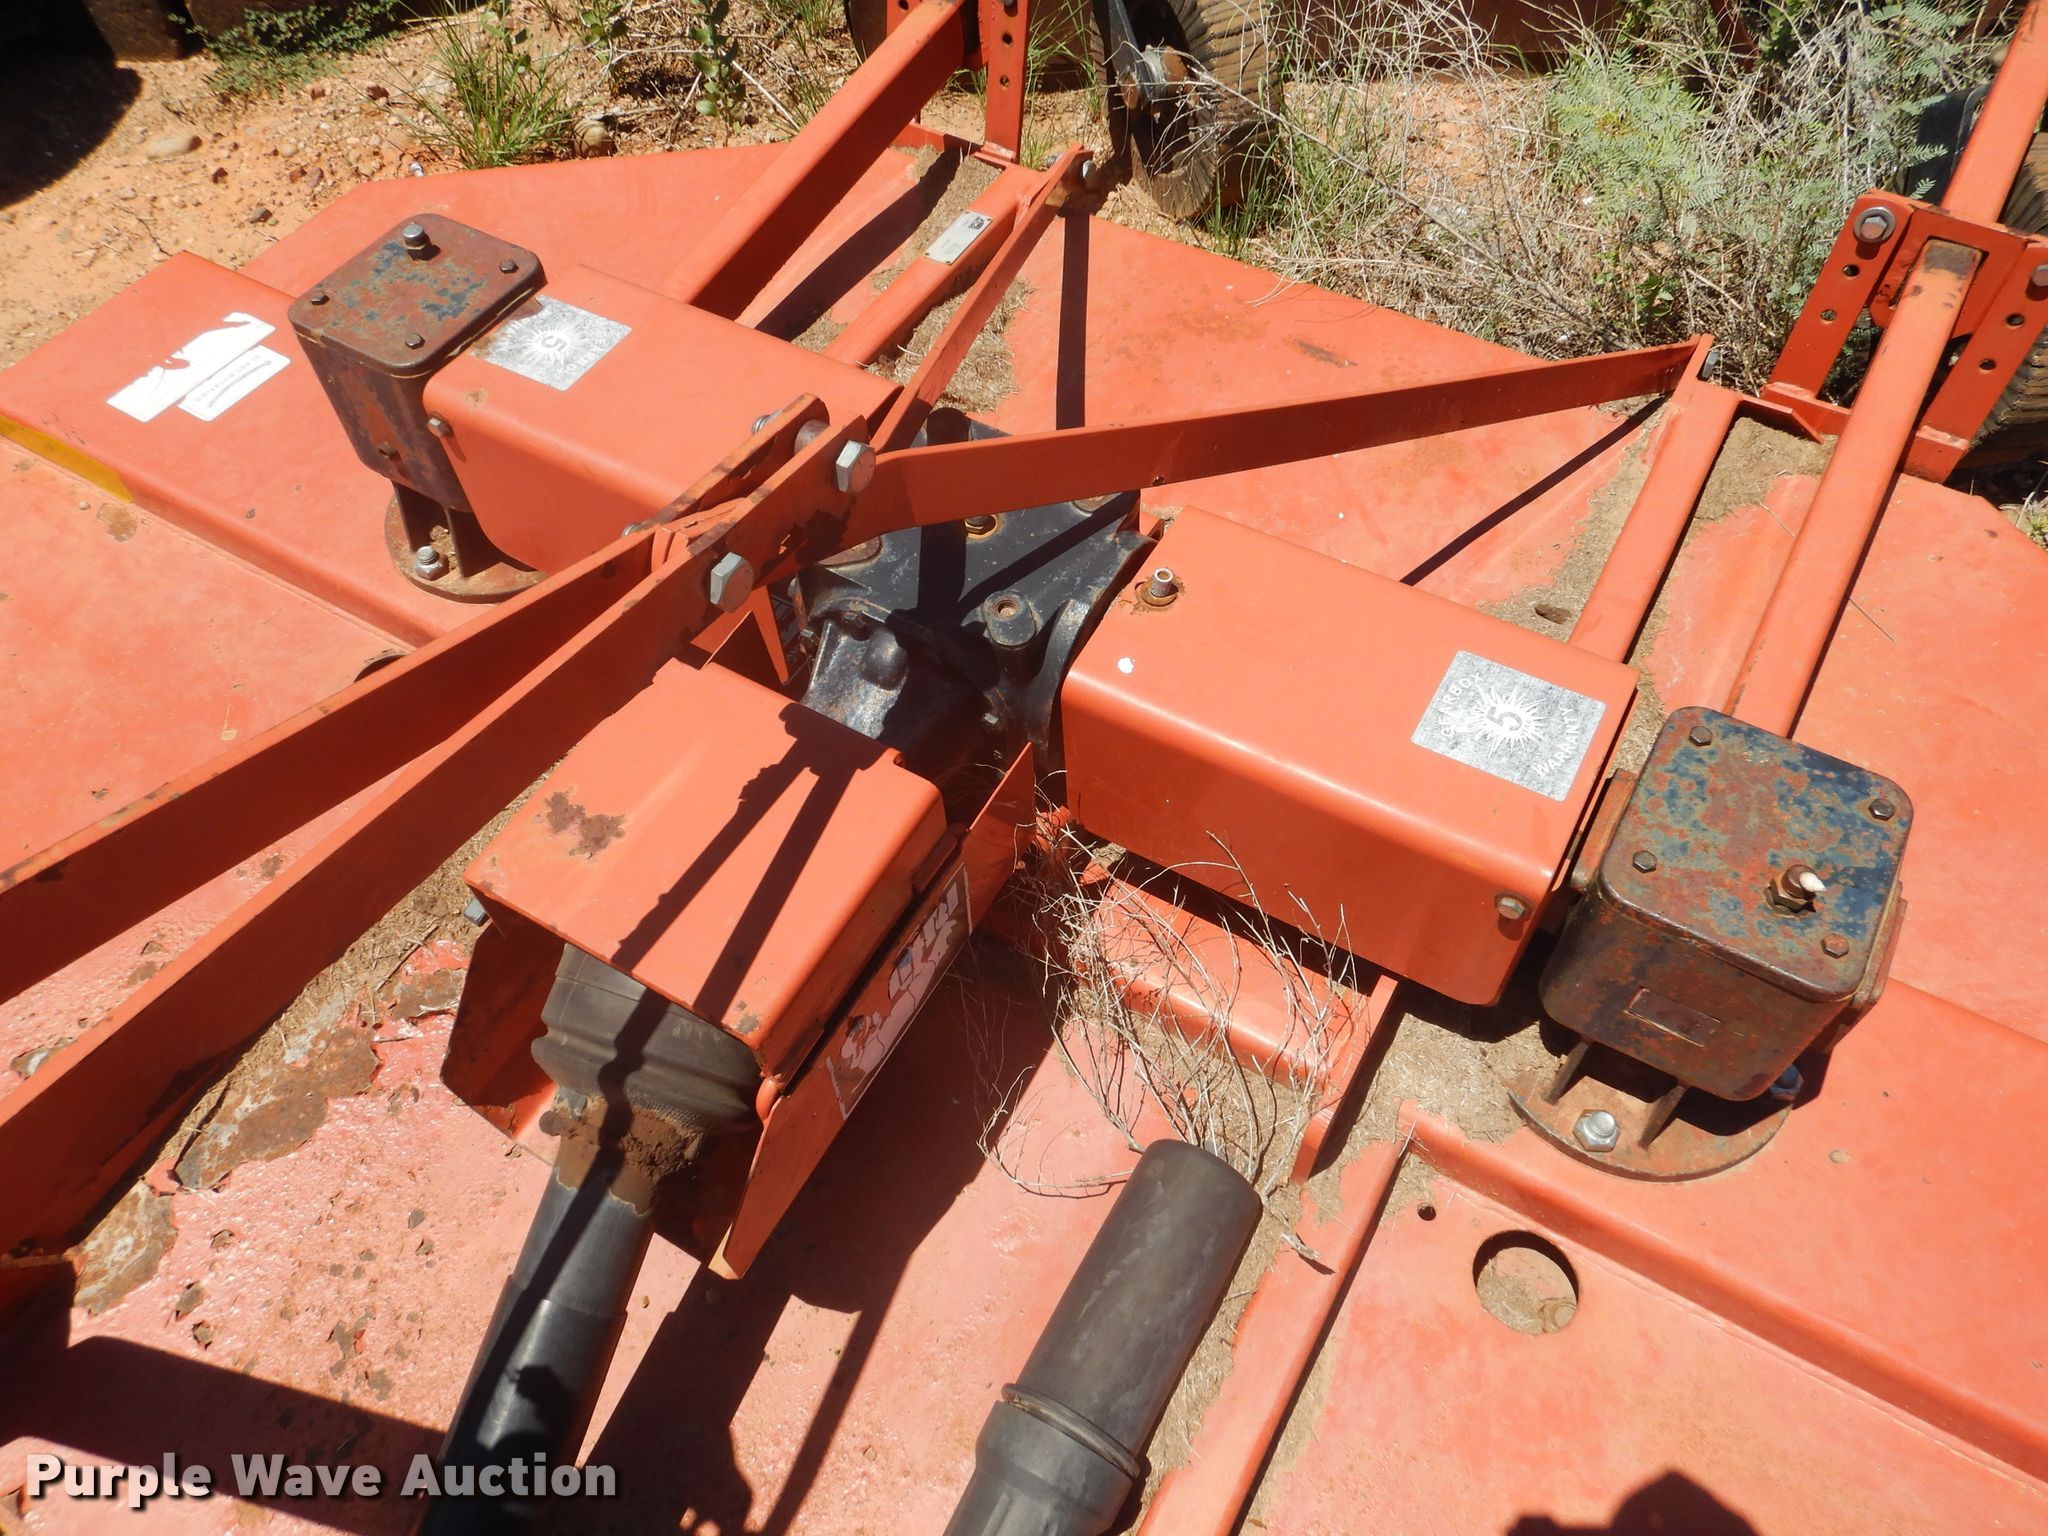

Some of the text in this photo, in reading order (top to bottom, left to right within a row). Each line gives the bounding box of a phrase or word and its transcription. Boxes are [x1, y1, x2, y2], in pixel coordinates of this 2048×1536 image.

[541, 335, 568, 351] 5
[1440, 672, 1484, 738] GEARBOX
[1486, 706, 1523, 731] 5
[1533, 707, 1580, 777] WARRANTY
